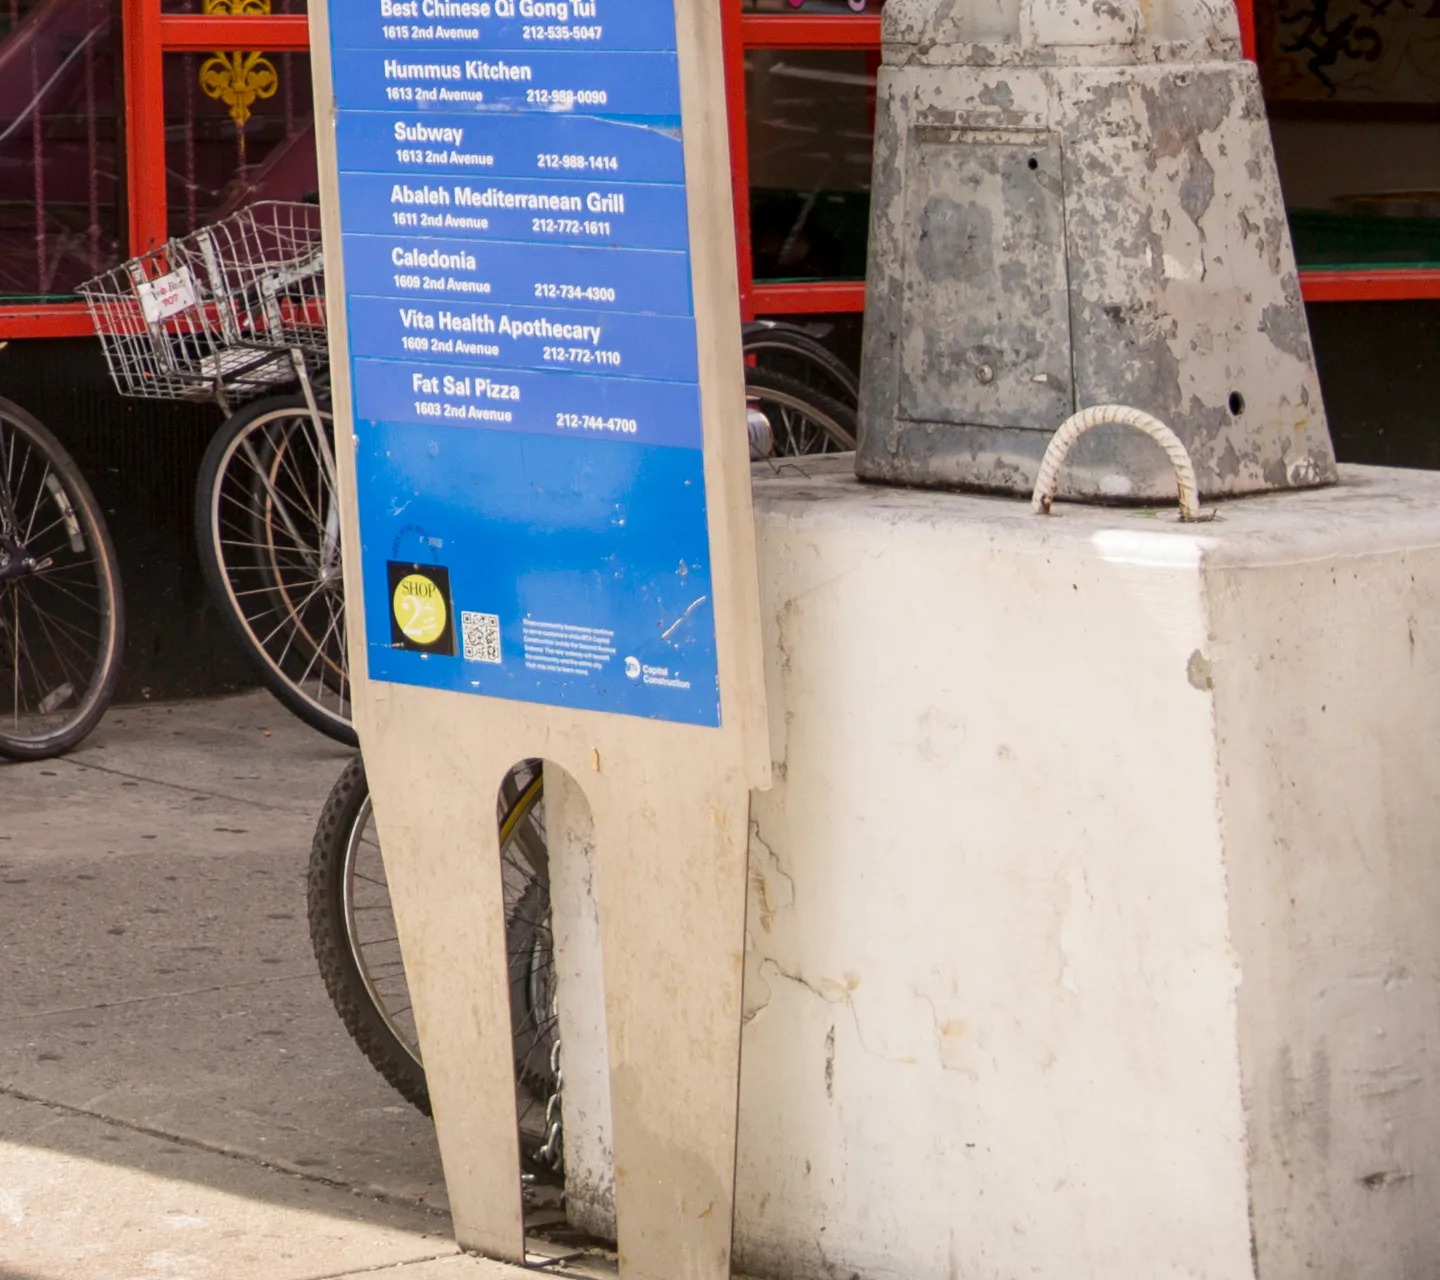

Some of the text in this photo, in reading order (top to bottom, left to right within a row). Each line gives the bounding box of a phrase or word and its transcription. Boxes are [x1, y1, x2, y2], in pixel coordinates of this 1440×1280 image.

[382, 25, 602, 40] 1615 2nd Avenue 212-535-5047
[384, 59, 532, 80] Hummus Kitchen
[386, 86, 607, 104] 1613 2nd Avenue 212-988-0090
[394, 121, 463, 146] Subway
[396, 149, 618, 170] 1613 2nd Avenue 212-988-1414
[390, 185, 625, 214] Abaleh Mediterranean Grill
[392, 212, 610, 235] 1611 2nd Avenue 212-772-1611
[391, 247, 476, 271] Caledonia
[393, 275, 615, 301] 1609 2nd Avenue 212-734-4300
[399, 308, 601, 345] Vita Health Apothecary
[401, 336, 621, 365] 1609 2nd Avenue 212-772-1110
[412, 373, 520, 400] Fat Sal Pizza
[414, 401, 637, 433] 1603 2nd Avenue 212-744-4700
[401, 580, 437, 598] SHOP
